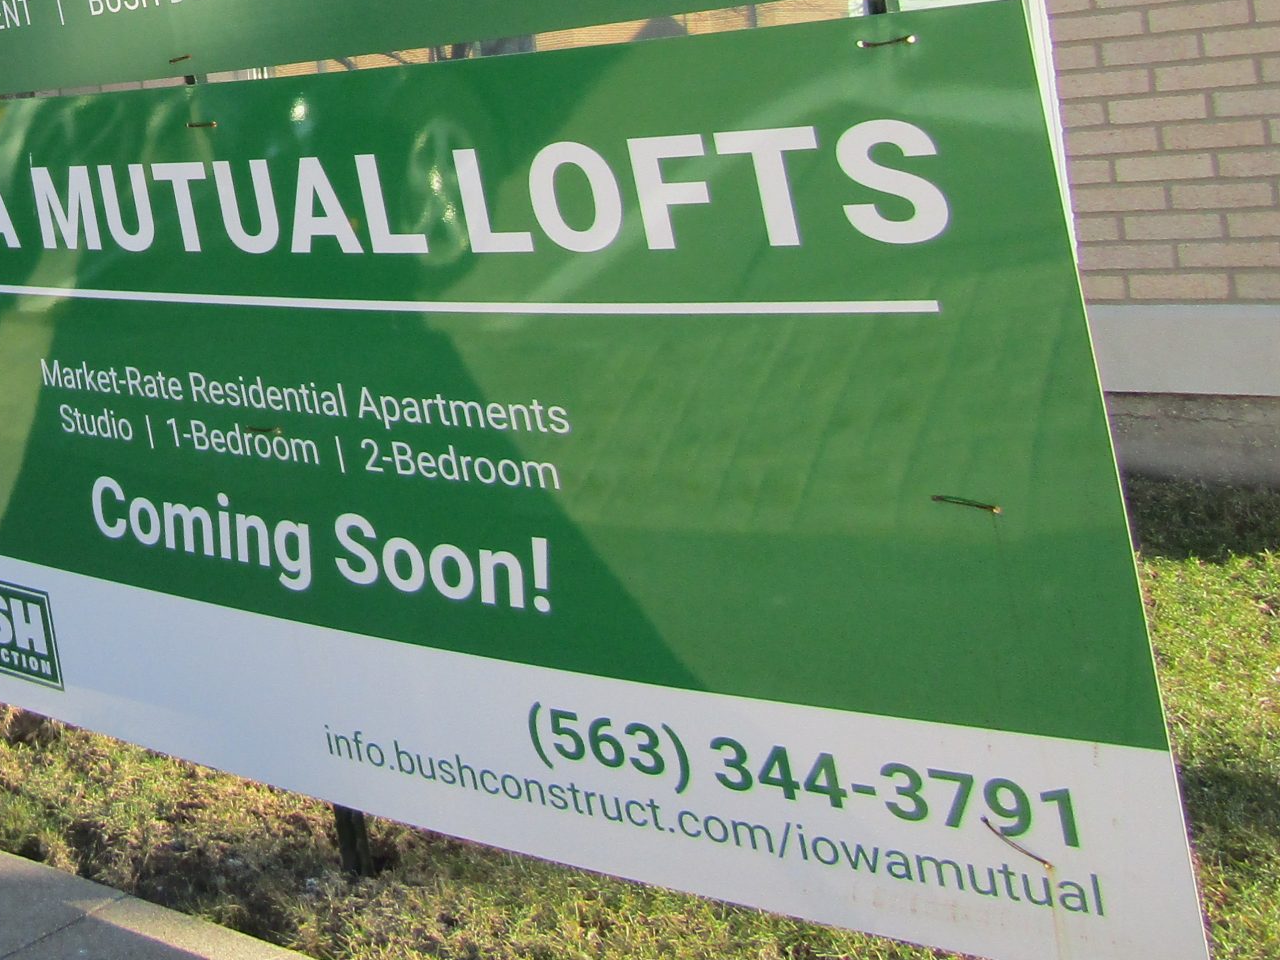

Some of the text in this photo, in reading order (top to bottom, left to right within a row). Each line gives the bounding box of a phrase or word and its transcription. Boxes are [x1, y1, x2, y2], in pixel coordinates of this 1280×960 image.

[30, 154, 429, 254] MUTUAL
[452, 119, 949, 253] LOFTS
[40, 358, 571, 434] Market-Rate Residential Apartments
[60, 404, 561, 490] Studio 1-Bedroom 2-Bedroom
[91, 476, 551, 613] Coming Soon!
[324, 724, 1106, 917] info.bushconstruct.com/iowamutual
[528, 701, 1082, 849] (563) 344-3791
